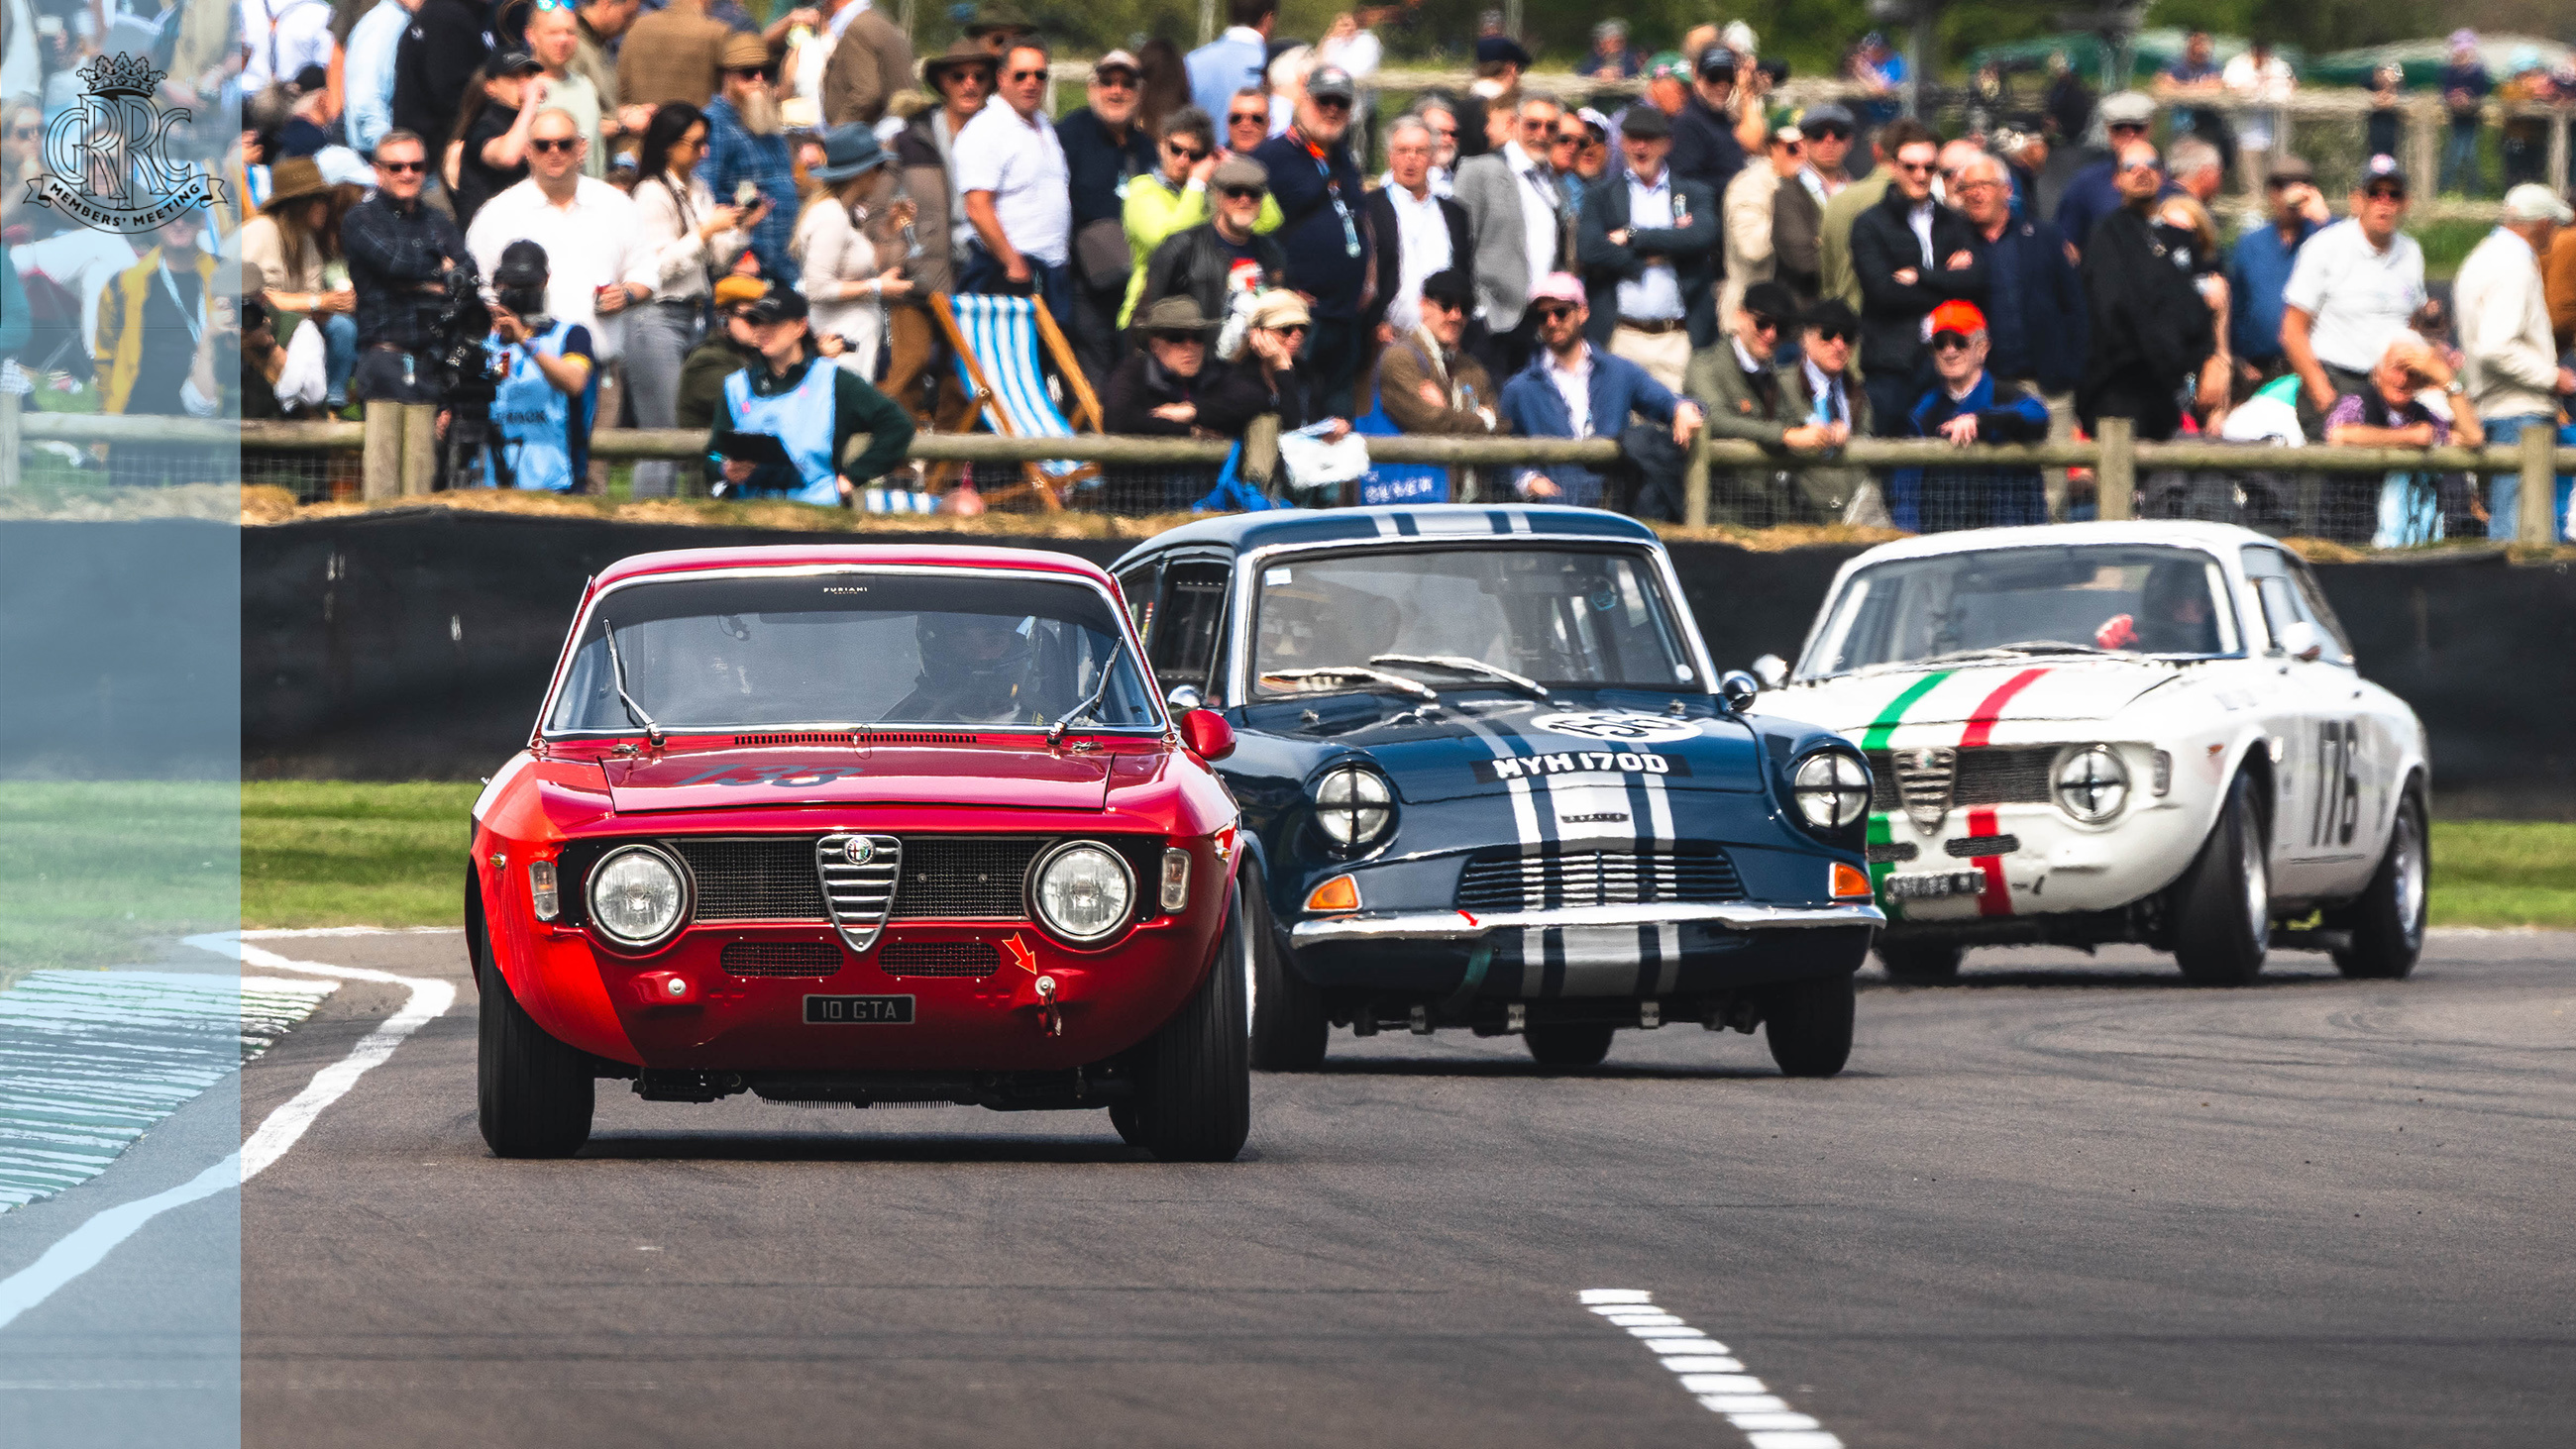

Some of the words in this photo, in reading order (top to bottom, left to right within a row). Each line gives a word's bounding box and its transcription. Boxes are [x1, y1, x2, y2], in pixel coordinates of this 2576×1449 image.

[1549, 715, 1685, 738] 156
[673, 763, 864, 787] 133
[1492, 753, 1575, 778] MYH
[1579, 753, 1669, 774] 170D
[2310, 720, 2359, 847] 176
[822, 1001, 842, 1018] 10
[853, 1001, 897, 1018] GTA
